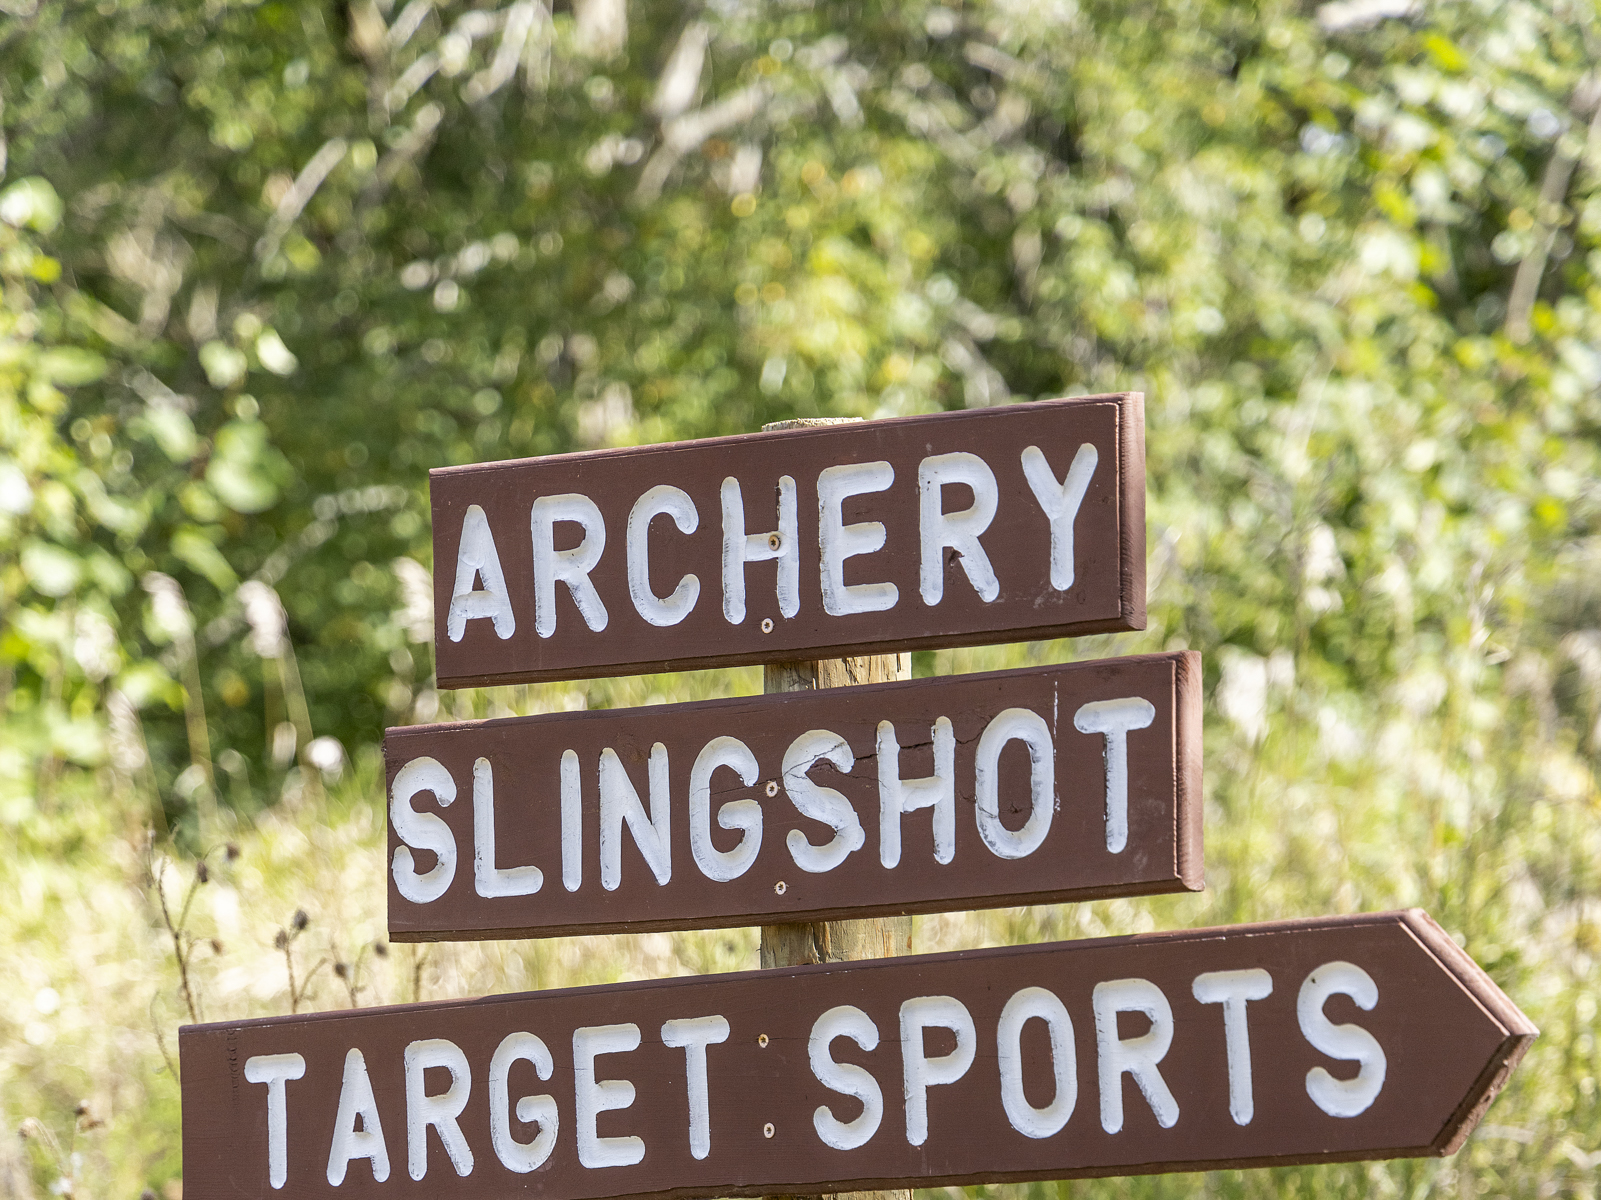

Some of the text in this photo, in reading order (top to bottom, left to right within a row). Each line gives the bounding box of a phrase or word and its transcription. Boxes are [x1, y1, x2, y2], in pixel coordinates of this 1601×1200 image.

[446, 442, 1099, 643] ARCHERY
[389, 696, 1156, 904] SLINGSHOT
[243, 961, 1387, 1190] TARGET SPORTS
